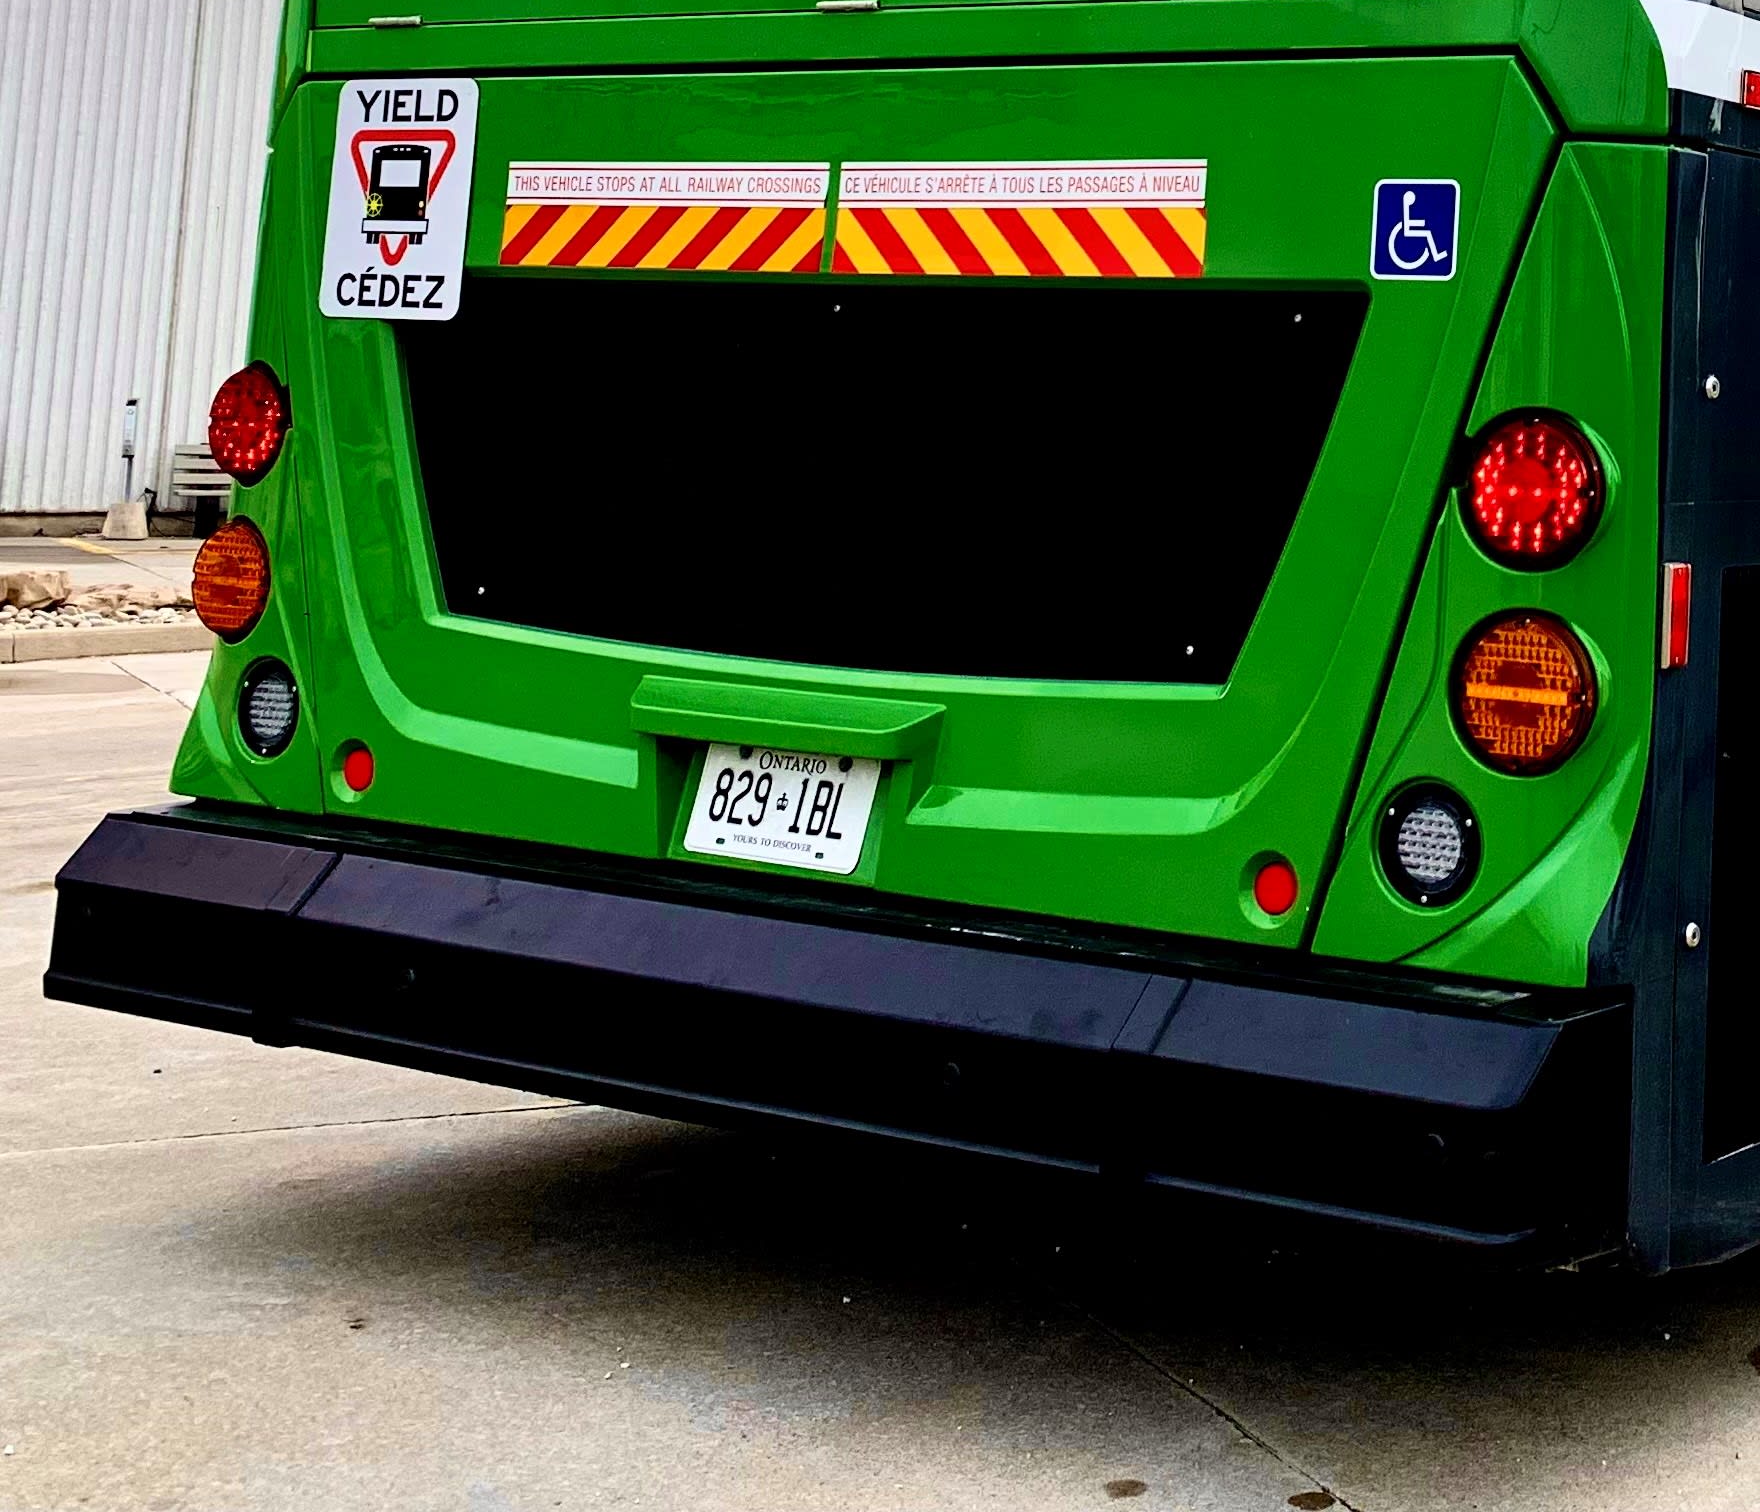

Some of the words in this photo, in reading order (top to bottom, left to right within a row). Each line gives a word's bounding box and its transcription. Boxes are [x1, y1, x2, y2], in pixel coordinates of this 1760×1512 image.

[356, 89, 459, 123] YIELD
[514, 175, 540, 192] THIS
[543, 175, 592, 193] VEHICLE
[596, 176, 635, 193] STOPS
[639, 176, 656, 193] AT
[660, 176, 682, 194] ALL
[687, 176, 743, 194] RAILWAY
[747, 176, 822, 195] CROSSINGS
[845, 176, 861, 194] CE
[863, 173, 921, 194] VÉHICULE
[925, 173, 985, 195] S'ARRÊTE
[989, 172, 998, 194] À
[1001, 175, 1035, 194] TOUS
[1039, 175, 1063, 193] LES
[1067, 175, 1135, 194] PASSAGES
[1138, 171, 1149, 194] À
[1152, 174, 1201, 193] NIVEAU
[335, 266, 444, 309] CÉDEZ
[759, 751, 827, 775] ONTARIO
[709, 767, 773, 827] 829
[788, 778, 843, 840] 1BL
[733, 834, 758, 845] YOURS
[760, 839, 771, 847] TO
[773, 840, 812, 853] DISCOVER
